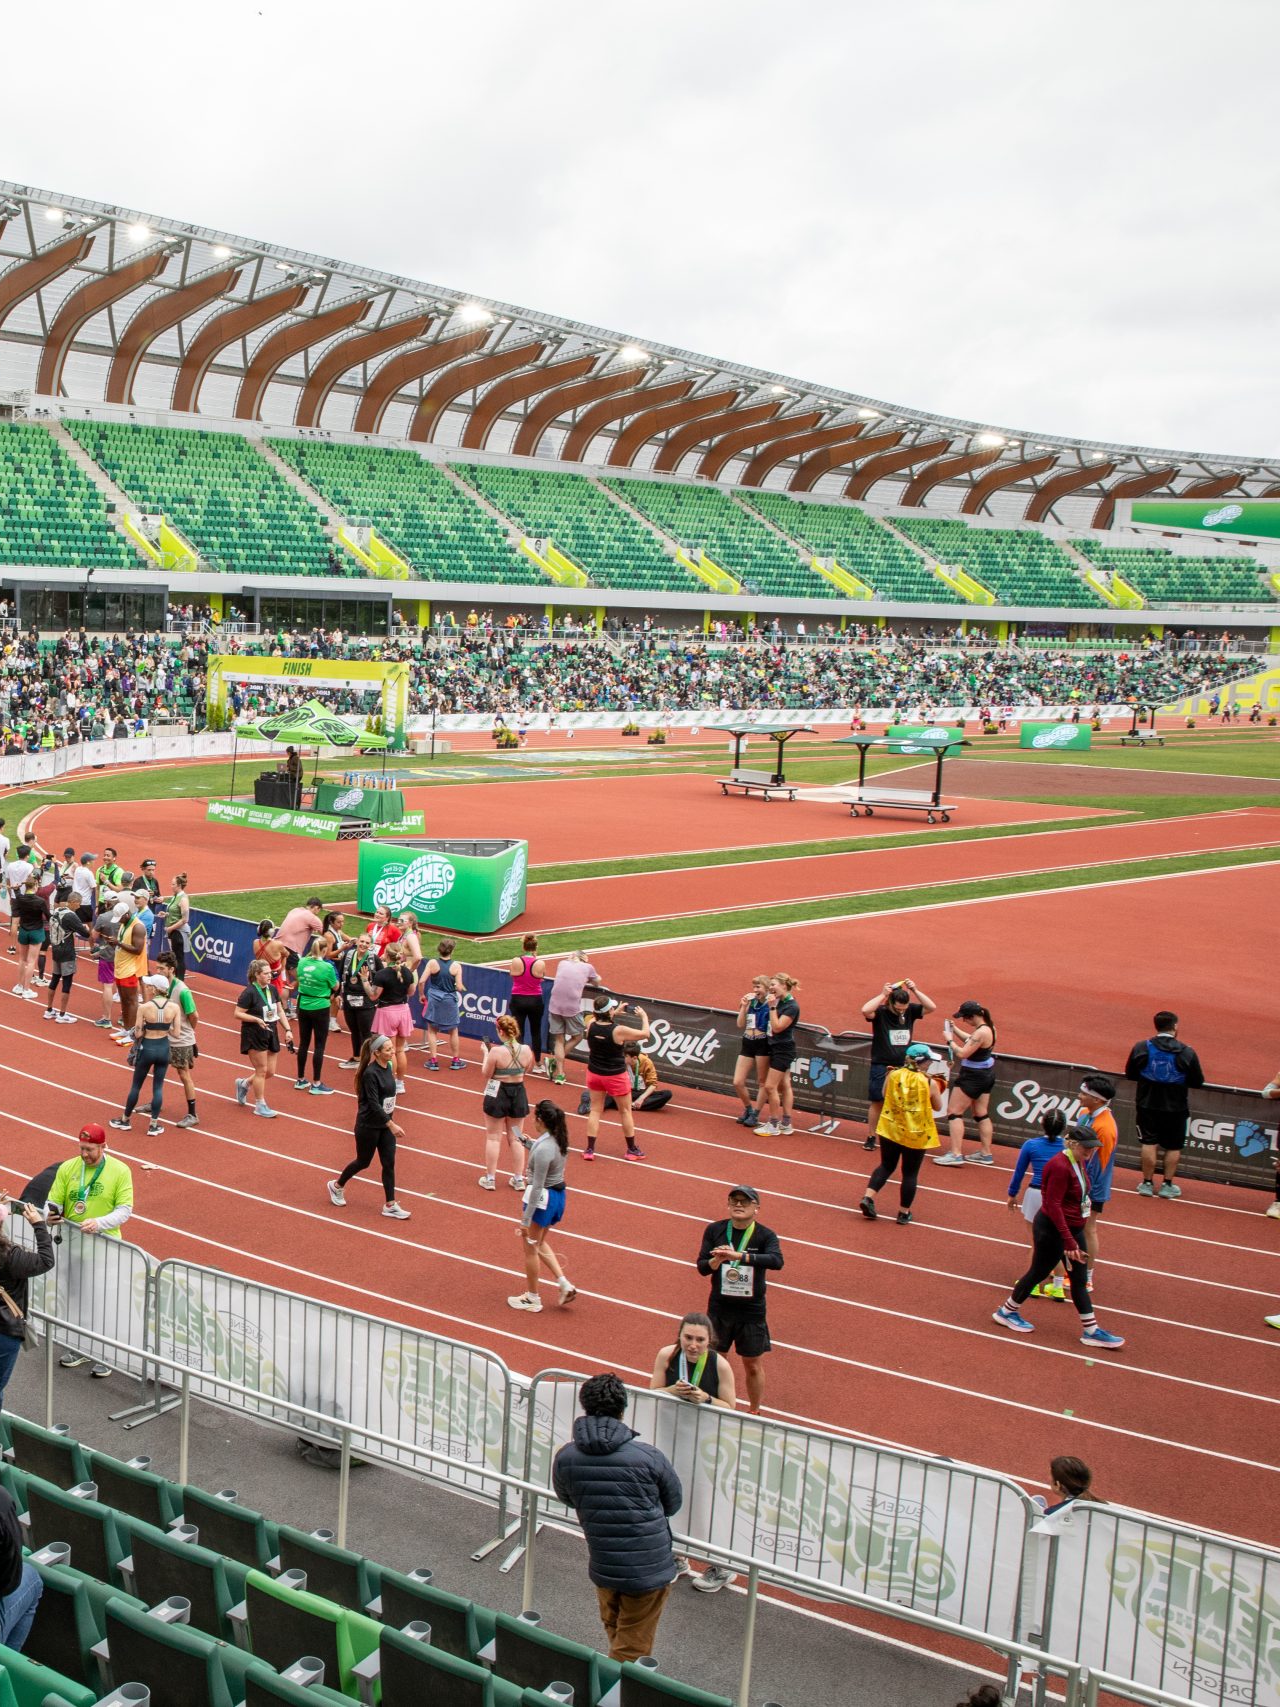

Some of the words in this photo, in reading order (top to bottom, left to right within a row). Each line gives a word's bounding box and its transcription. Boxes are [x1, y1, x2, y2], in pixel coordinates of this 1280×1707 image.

[282, 662, 312, 676] FINISH
[385, 679, 397, 733] FINISH
[386, 863, 444, 904] EUGENE
[194, 934, 234, 958] OCCU
[206, 953, 219, 961] CREDIT
[466, 1012, 486, 1020] CREDIT
[638, 1019, 721, 1067] Spylt
